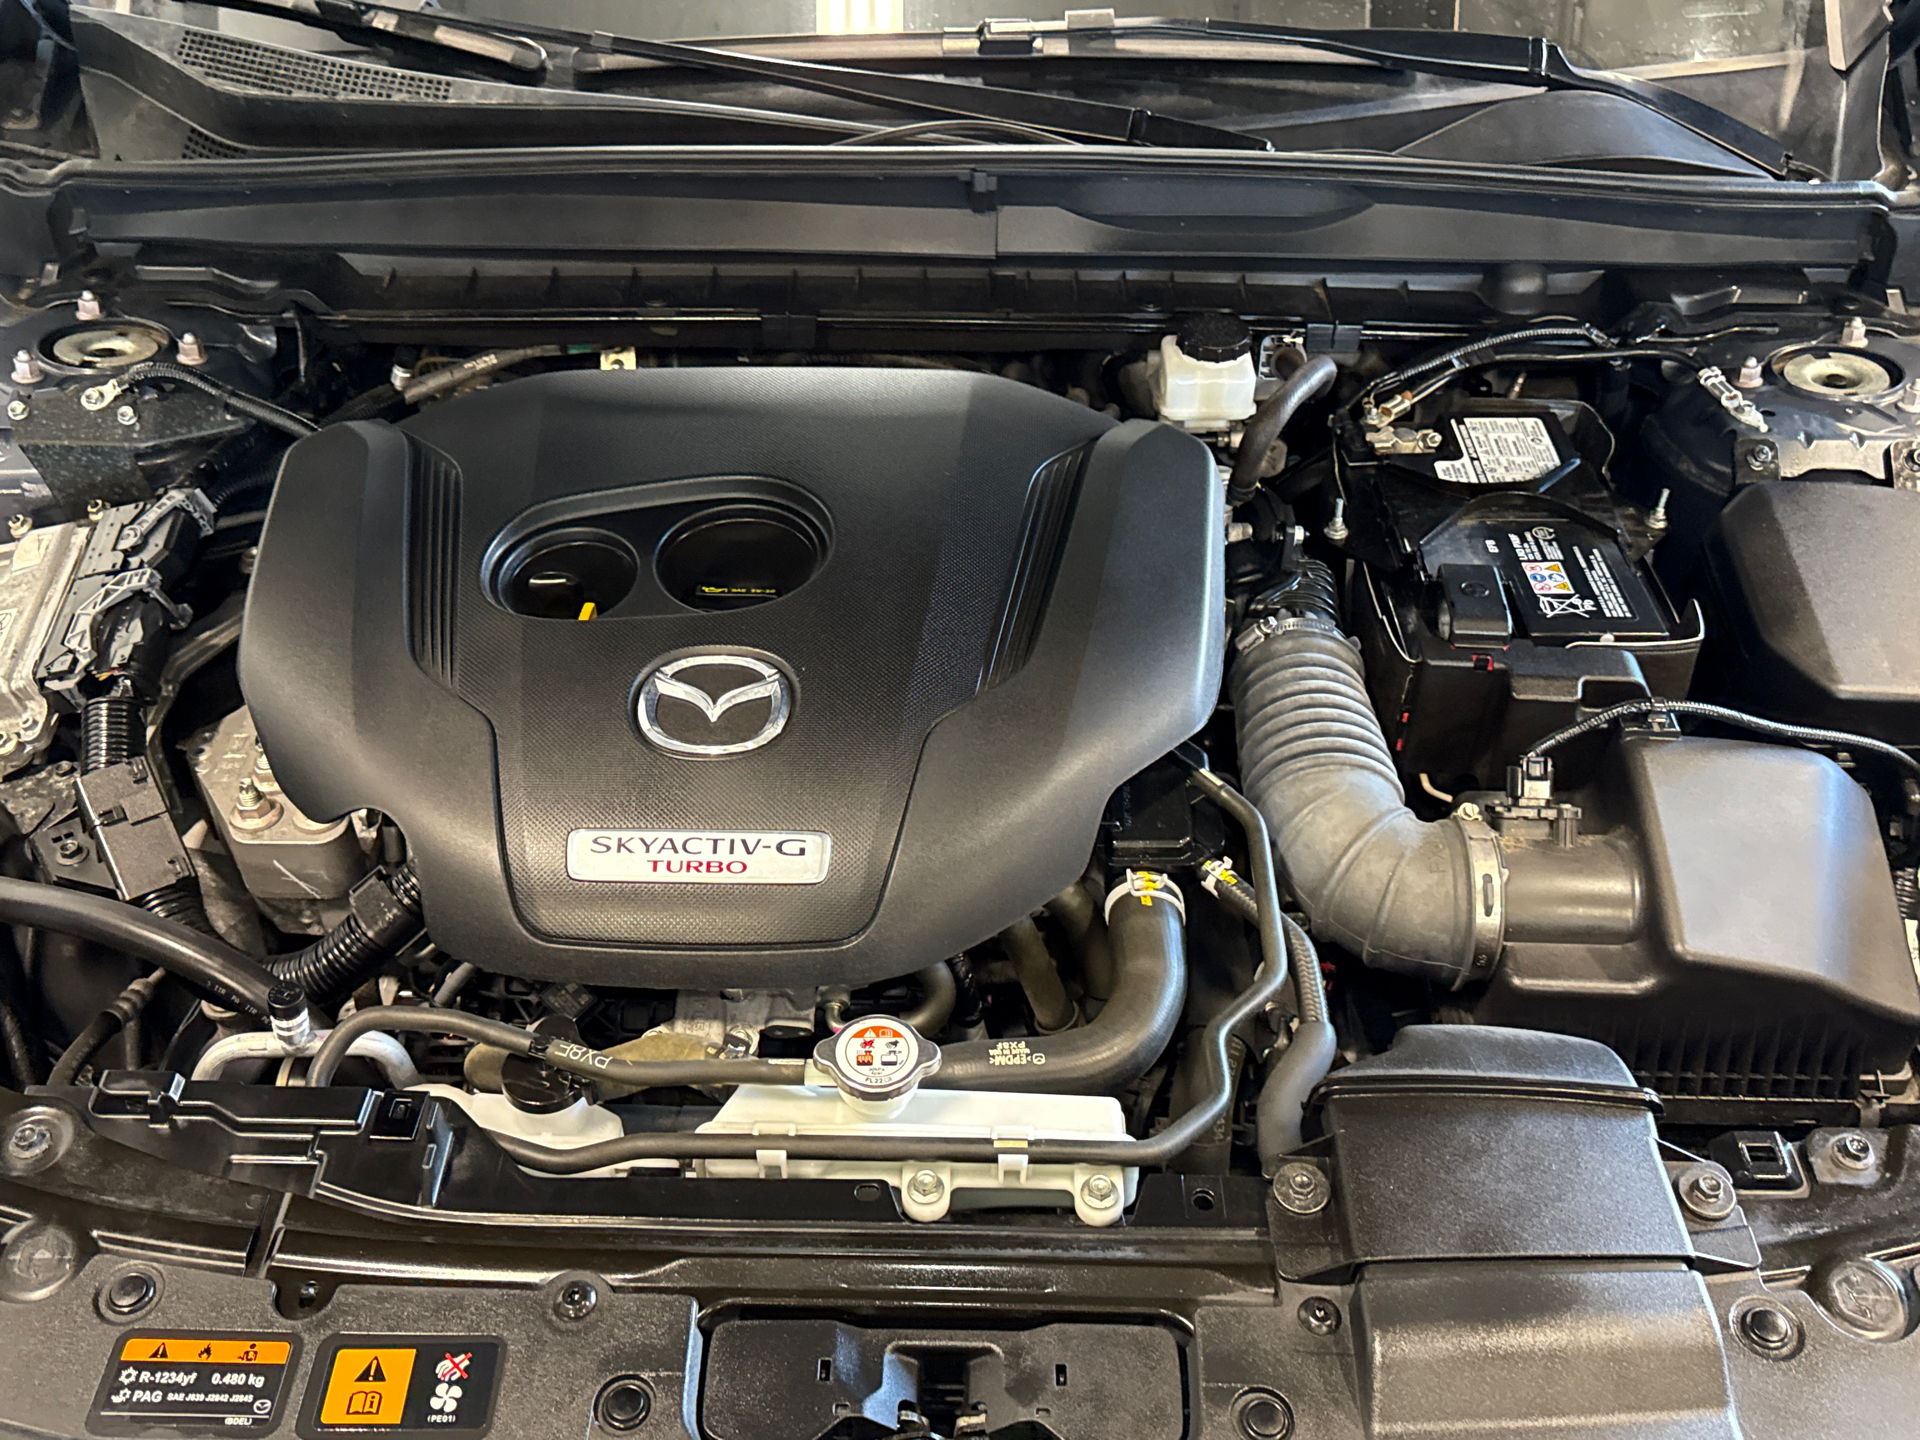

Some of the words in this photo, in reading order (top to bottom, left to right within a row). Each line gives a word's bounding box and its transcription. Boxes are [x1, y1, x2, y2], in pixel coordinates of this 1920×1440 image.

[1583, 599, 1597, 611] Pb
[590, 836, 806, 857] SKYACTIV-G
[647, 860, 748, 875] TURBO
[554, 1043, 613, 1069] PX8F
[138, 1371, 198, 1387] R-1234yf
[211, 1373, 247, 1385] 0.480
[247, 1373, 265, 1388] kg
[132, 1390, 163, 1402] PAG
[166, 1393, 184, 1401] SAE
